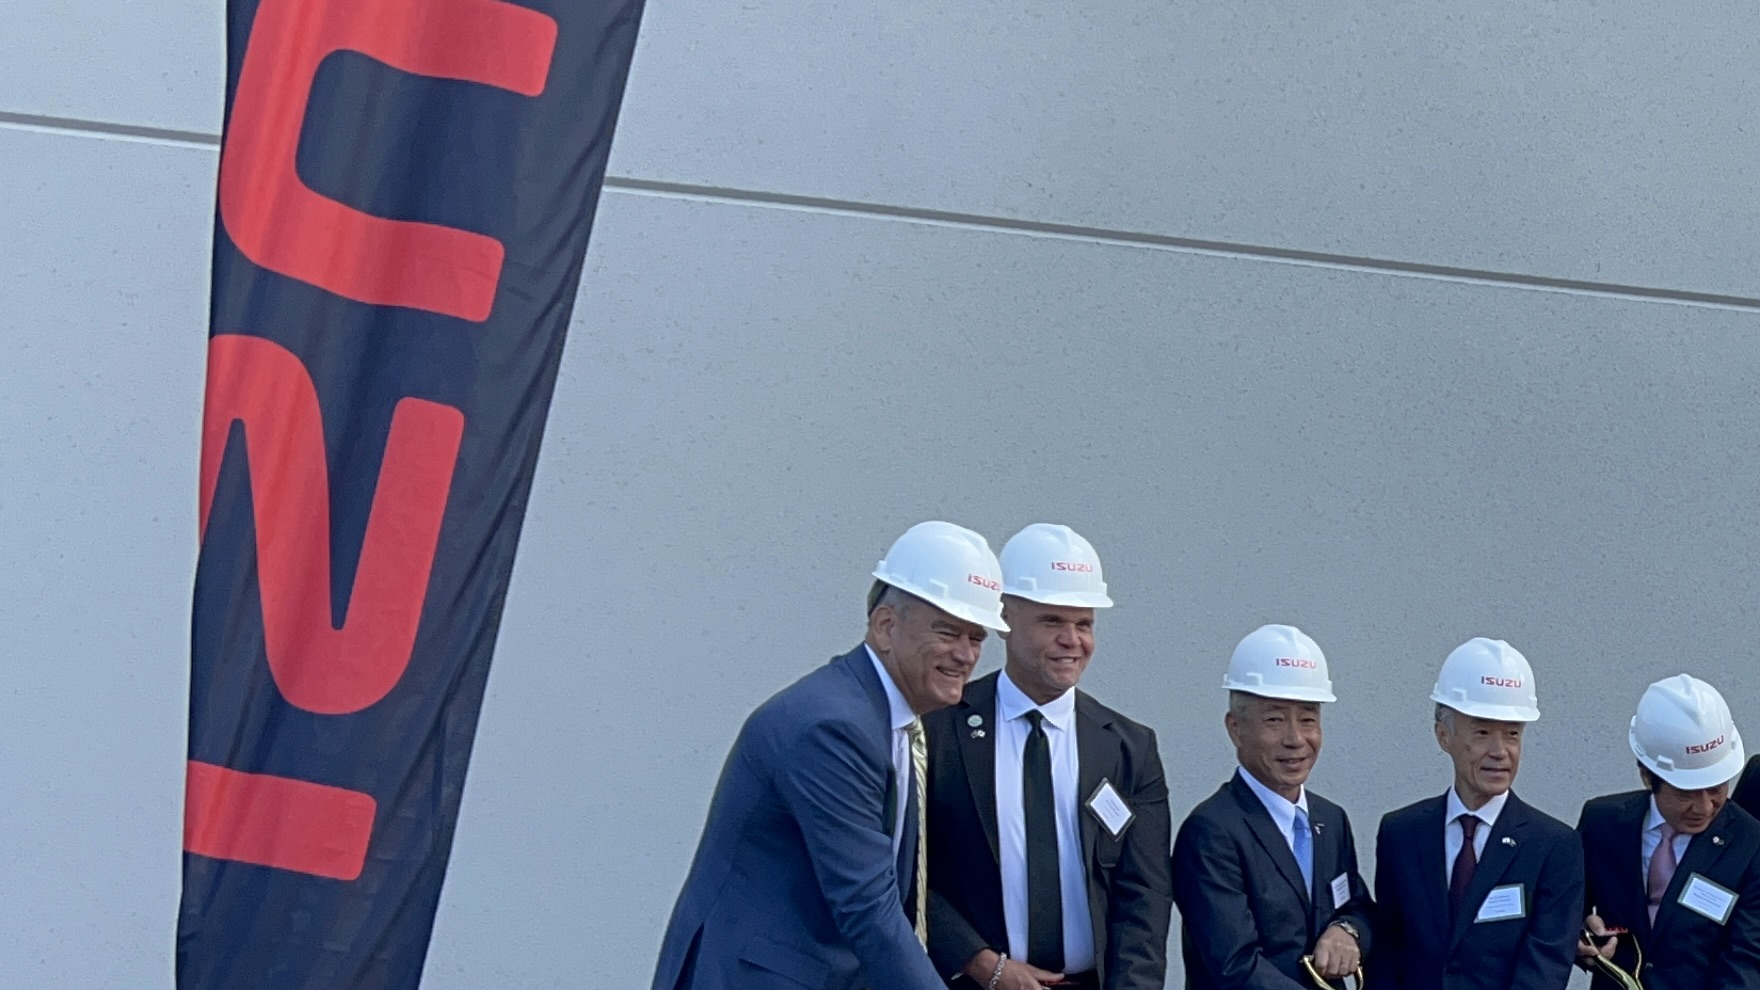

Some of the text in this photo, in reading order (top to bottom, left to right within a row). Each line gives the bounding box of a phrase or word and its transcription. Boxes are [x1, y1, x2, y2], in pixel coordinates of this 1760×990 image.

[1051, 560, 1094, 574] ISUZU
[1276, 657, 1317, 669] ISUZU
[1481, 676, 1522, 689] ISUZU
[1686, 734, 1725, 755] ISUZU
